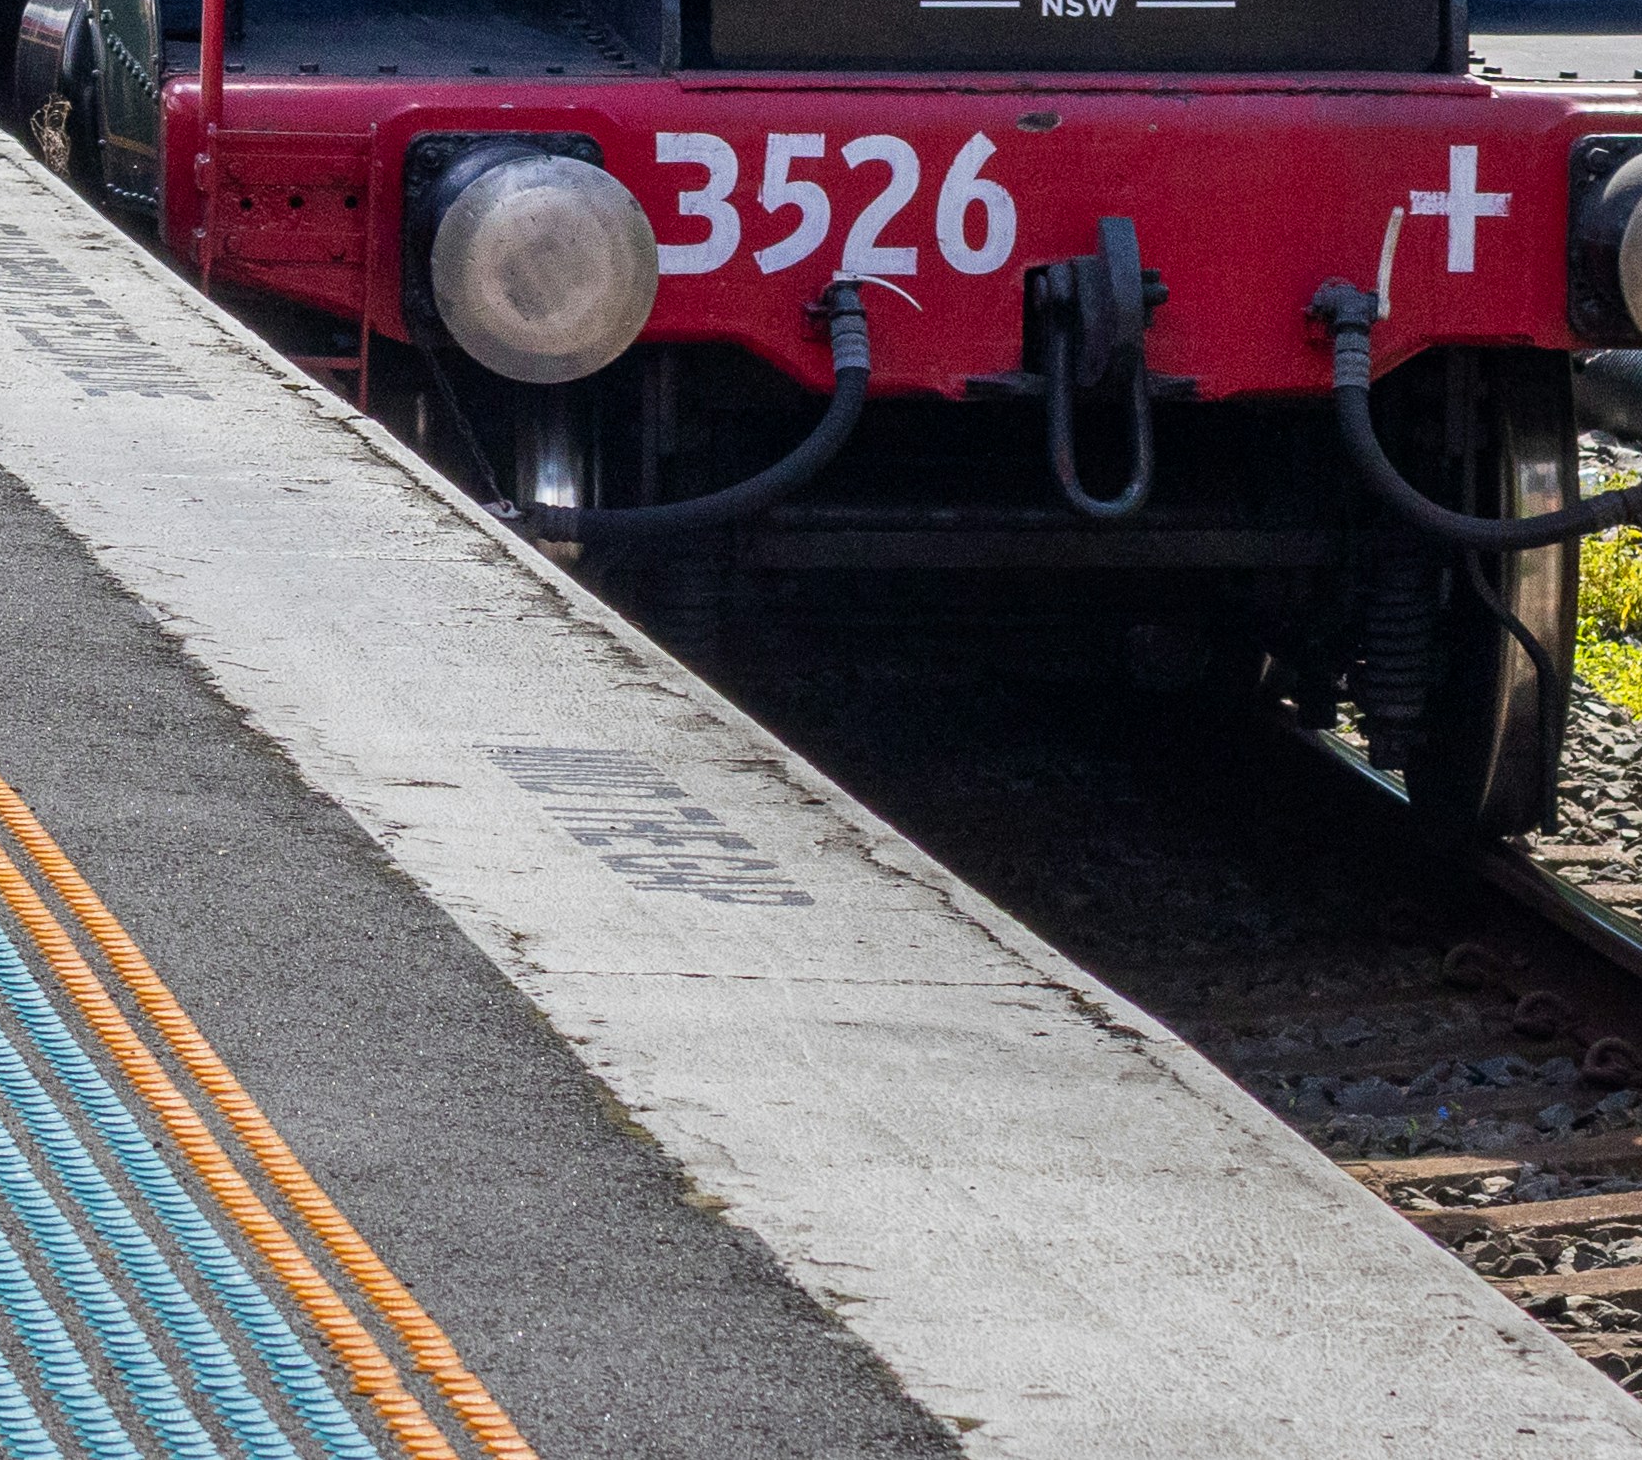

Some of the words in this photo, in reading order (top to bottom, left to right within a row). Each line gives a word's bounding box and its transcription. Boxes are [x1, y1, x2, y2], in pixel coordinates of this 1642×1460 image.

[656, 131, 1018, 276] 3526
[543, 806, 757, 850] THE
[598, 853, 816, 906] GAP
